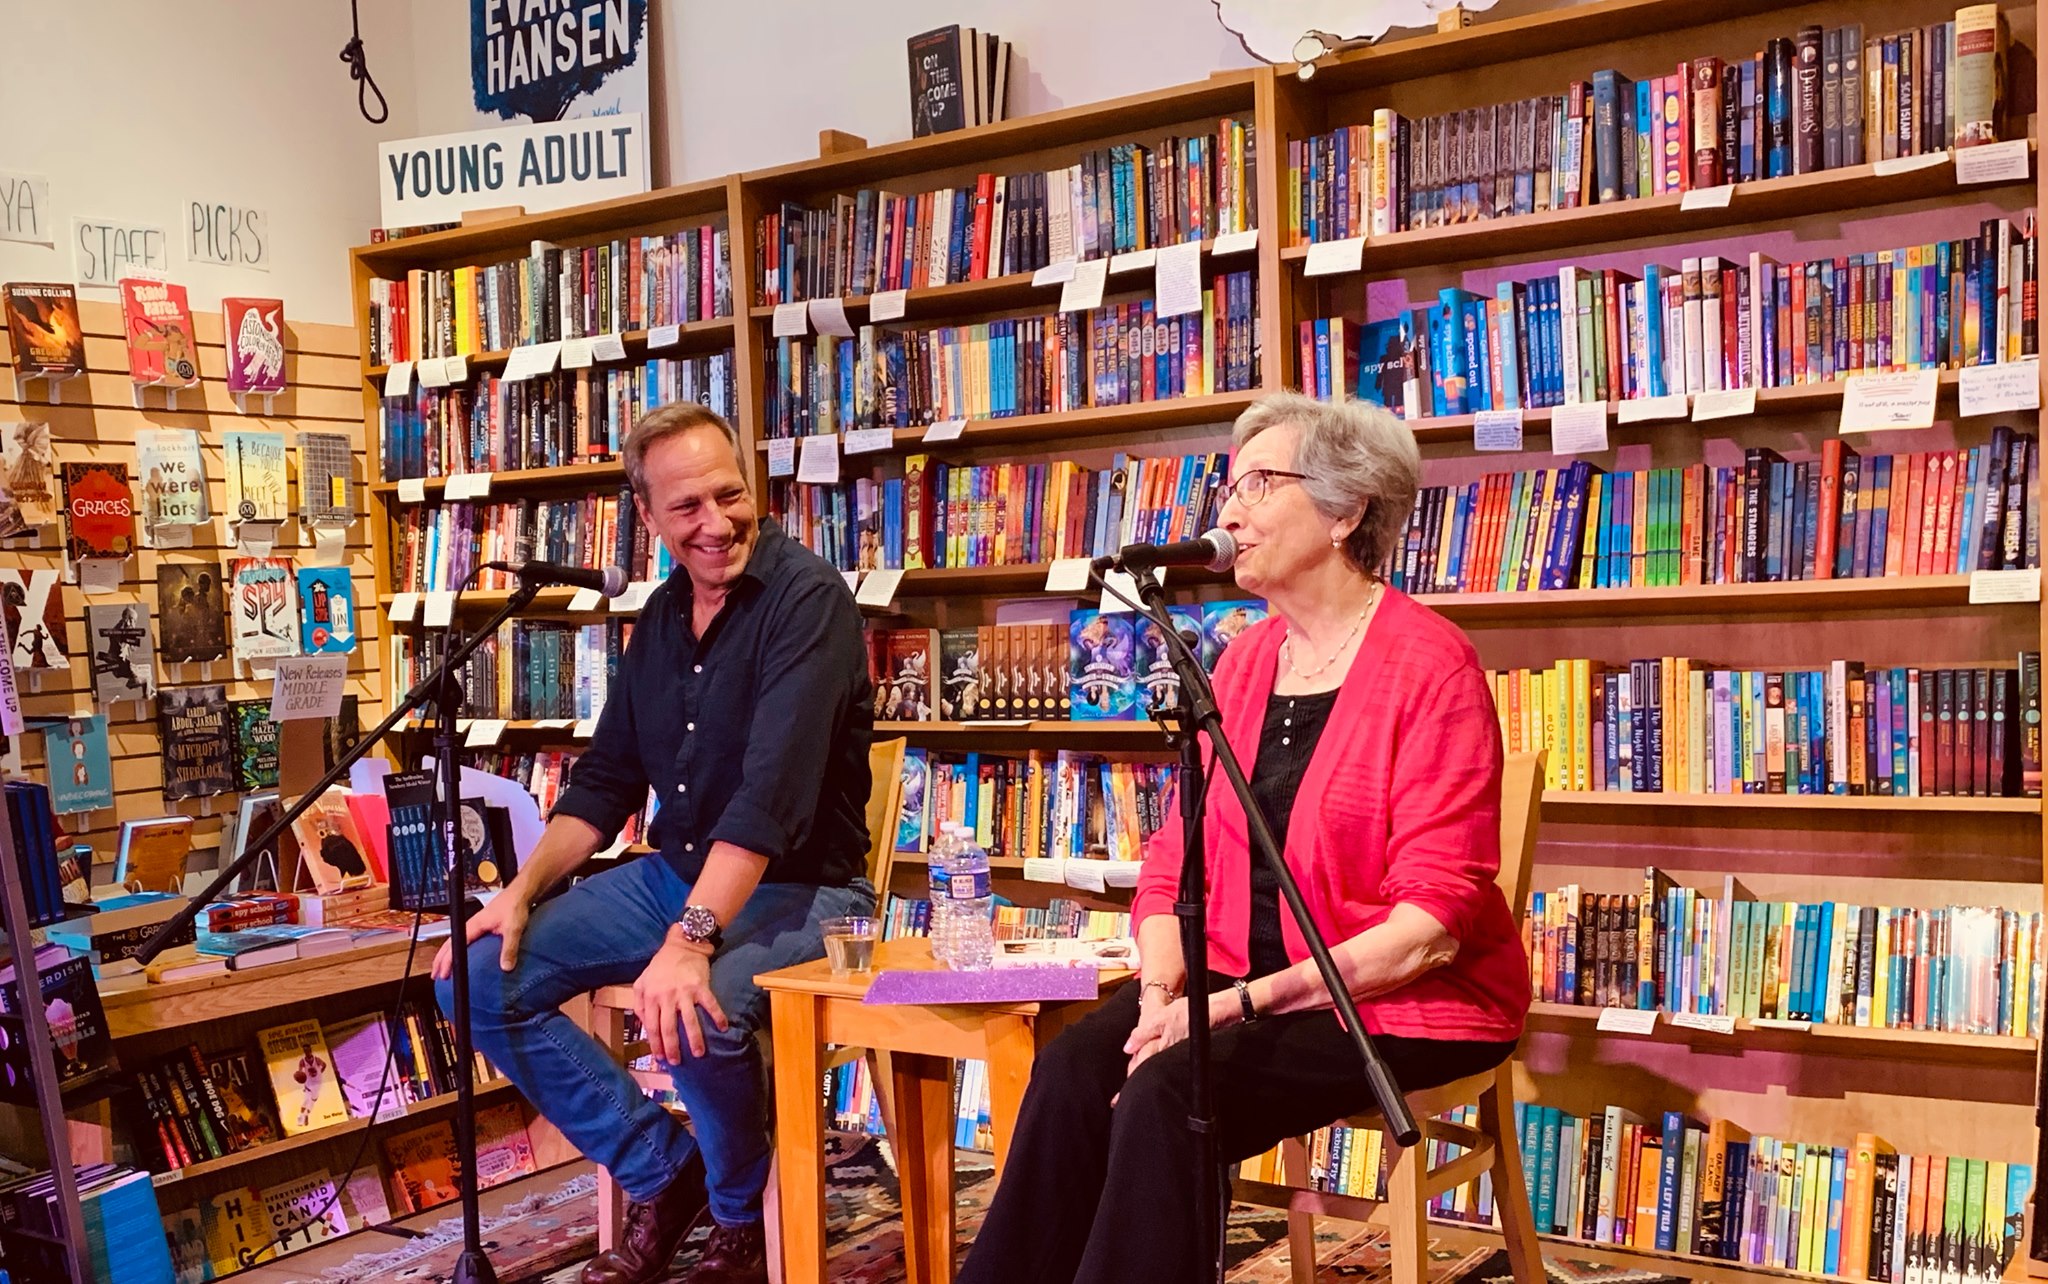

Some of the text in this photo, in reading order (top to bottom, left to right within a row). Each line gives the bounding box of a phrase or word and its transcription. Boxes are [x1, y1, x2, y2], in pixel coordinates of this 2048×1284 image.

[487, 0, 630, 95] HANSEN
[924, 54, 939, 70] ON
[930, 67, 950, 83] THE
[927, 82, 957, 102] COME
[1799, 68, 1817, 132] DOLDRUMS
[1825, 80, 1840, 129] DOLDRUMS
[1845, 76, 1857, 126] DOLDRUMS
[931, 102, 946, 118] UP
[1900, 82, 1911, 140] SCAR ISLAND
[1725, 103, 1734, 160] The Thief Lord
[388, 127, 632, 201] YOUNG ADULT
[1377, 143, 1385, 193] HARRIET SPY
[0, 178, 37, 235] YA
[191, 201, 262, 264] PICKS
[80, 223, 159, 282] STAFF
[951, 251, 960, 275] World
[688, 239, 697, 306] STORMCASTER
[12, 288, 72, 298] SUZANNE COLLINS
[1059, 320, 1067, 350] BLUME
[1443, 324, 1453, 337] spy
[1502, 317, 1512, 365] lion down
[1738, 310, 1749, 374] METROPOLITANS
[1096, 349, 1105, 375] MAGIC
[1107, 326, 1116, 373] BAD MAGIC
[1186, 343, 1198, 357] the
[1419, 335, 1427, 370] spy camp
[1466, 332, 1478, 387] spaced out
[1492, 329, 1502, 391] waste space
[1364, 361, 1385, 374] spy
[530, 400, 539, 442] Starworld
[251, 441, 283, 460] BECAUSE
[160, 461, 186, 474] we
[151, 478, 200, 495] were
[244, 486, 266, 501] MEET
[72, 498, 131, 518] GRACES
[157, 497, 198, 517] liars
[1182, 482, 1200, 537] PERFECT SCORE
[1747, 489, 1757, 557] THE STRANGERS
[1985, 491, 1999, 523] TRAIL
[1692, 536, 1700, 557] GAME
[1805, 520, 1816, 557] SORROW
[243, 582, 287, 630] SPY
[314, 592, 326, 607] UP
[0, 659, 17, 713] COME UP
[279, 665, 343, 681] New Releases
[281, 681, 328, 697] MIDDLE
[1767, 675, 1782, 683] HOLT
[285, 696, 325, 711] GRADE
[171, 711, 223, 731] ABDUL-JABBAR
[251, 725, 276, 734] MAZEL
[1559, 704, 1568, 754] SQUIRM
[1576, 704, 1586, 754] SQUIRM
[1800, 715, 1808, 740] GREAT
[177, 740, 220, 761] MYCROFT
[252, 734, 276, 743] WOOD
[1609, 724, 1617, 759] DECEPTION
[1632, 712, 1643, 778] The Night Diary
[1651, 711, 1662, 778] The Night Diary
[1720, 722, 1728, 776] Cicada Moon
[1853, 722, 1862, 780] Same Sun Here
[176, 762, 225, 783] SHERLOCK
[234, 903, 274, 918] spy school
[234, 915, 273, 931] spy school
[112, 934, 126, 943] THE
[1583, 926, 1594, 961] REDWALL
[1860, 941, 1872, 990] ICE WOLVES
[202, 1078, 225, 1119] SHOE DOG
[1526, 1122, 1537, 1168] WHERE THE
[1541, 1125, 1554, 1200] WHERE THE HEART
[264, 1181, 319, 1204] EVERYTHING
[267, 1187, 328, 1214] BAND-AID
[1660, 1156, 1675, 1231] OUT LEFT FIELD
[1681, 1173, 1693, 1232] GREEN GLASS SEA
[1899, 1180, 1907, 1200] FAMILY
[272, 1197, 329, 1227] CAN'T
[1597, 1196, 1610, 1217] OK
[1898, 1203, 1906, 1220] GAME
